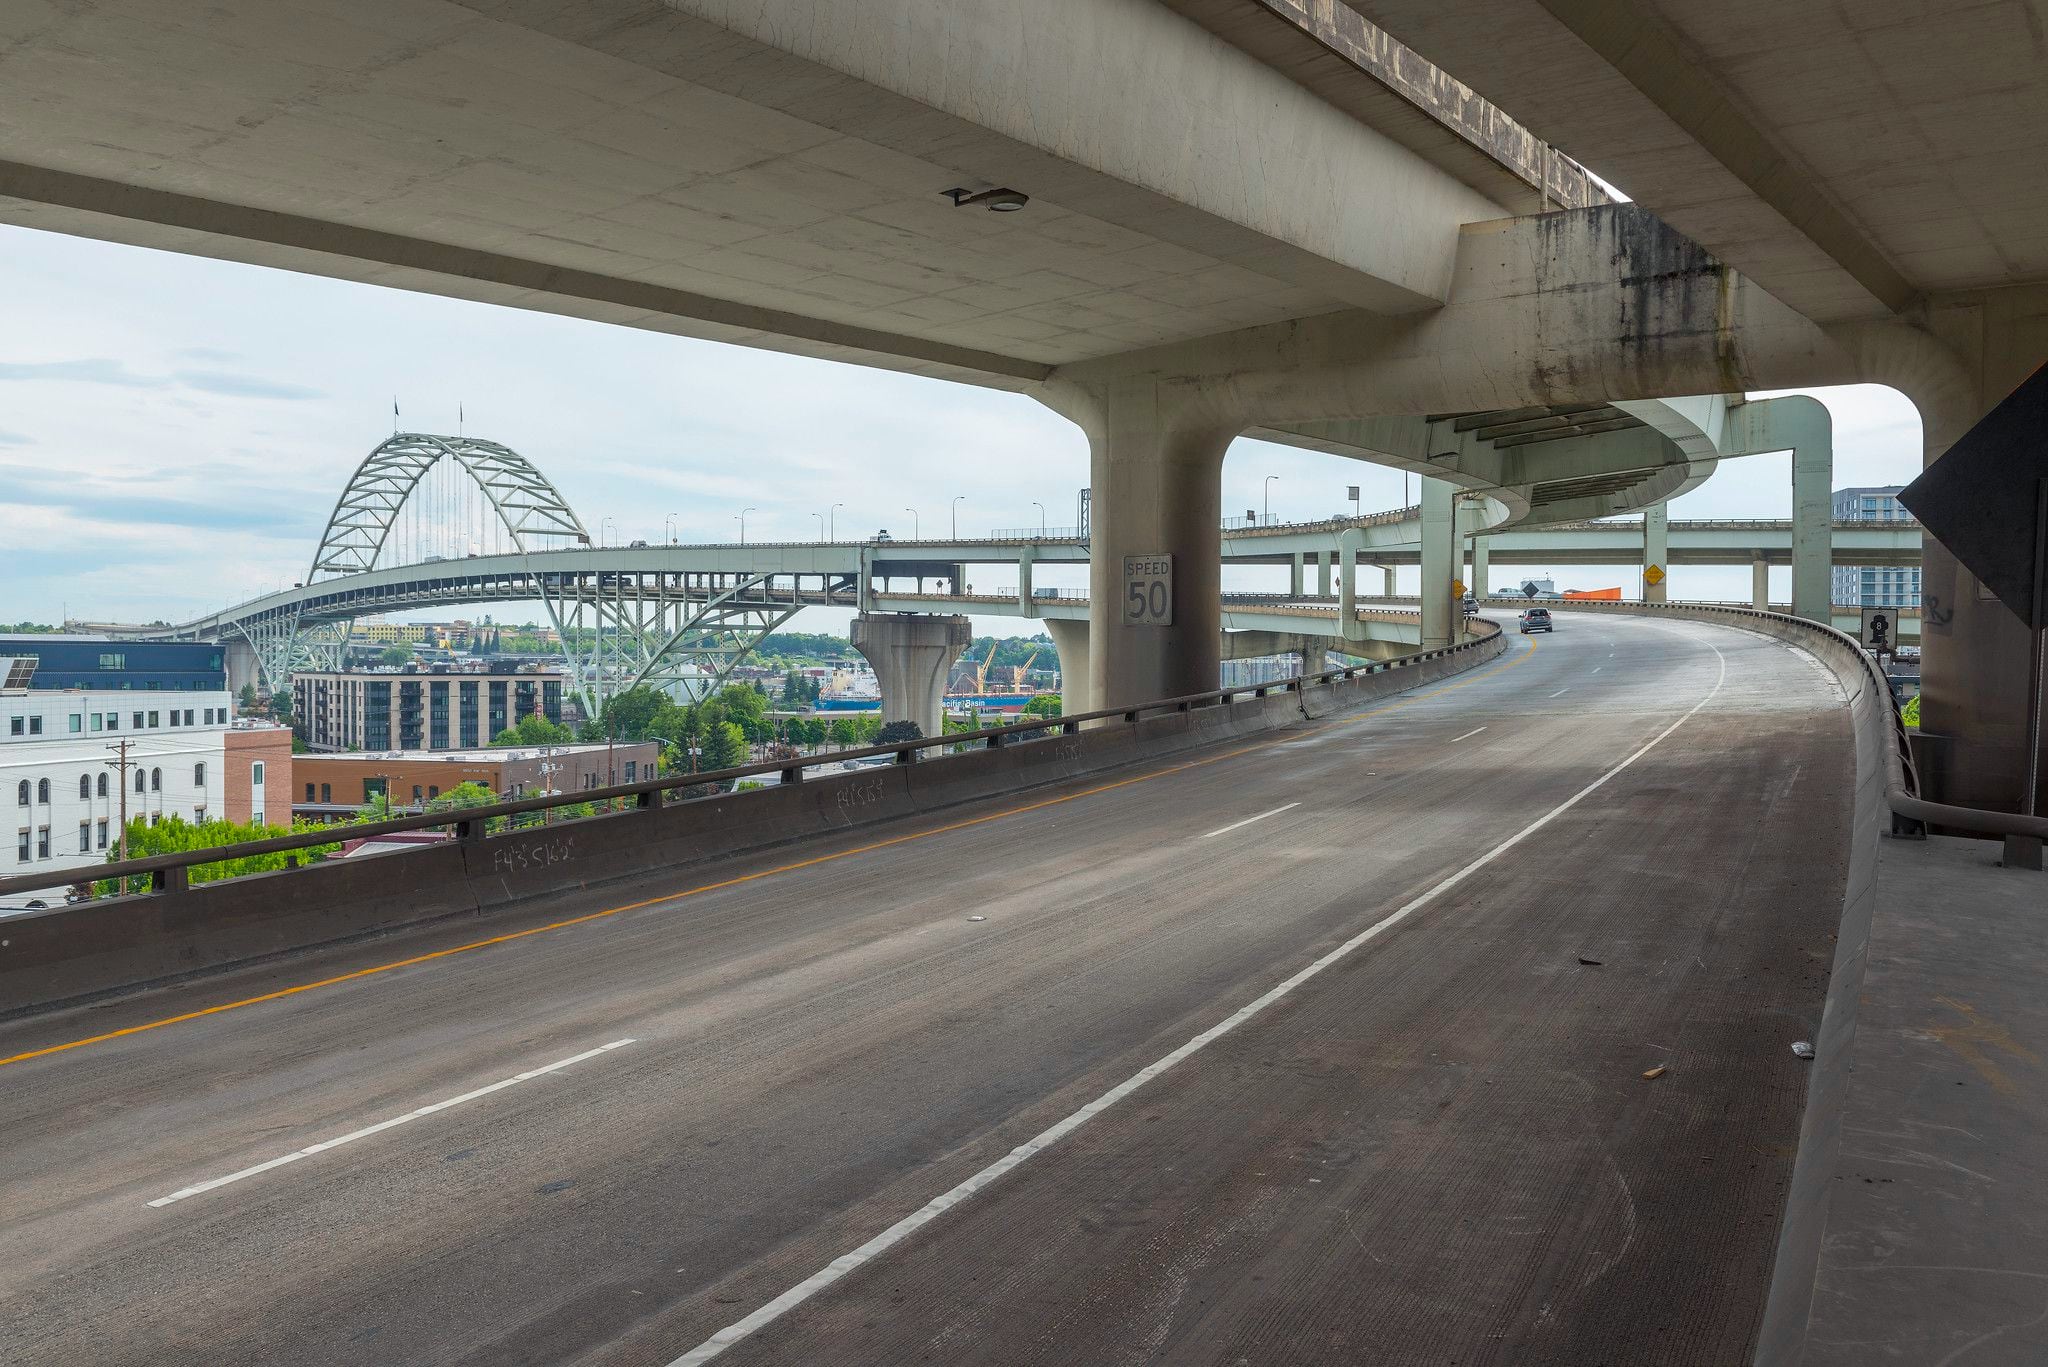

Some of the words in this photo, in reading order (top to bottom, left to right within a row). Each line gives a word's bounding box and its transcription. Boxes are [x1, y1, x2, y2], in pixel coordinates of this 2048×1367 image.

[1127, 562, 1169, 576] SPEED
[1129, 581, 1167, 618] 50
[1876, 622, 1882, 630] 8
[942, 699, 961, 708] acific
[964, 699, 986, 708] Basin
